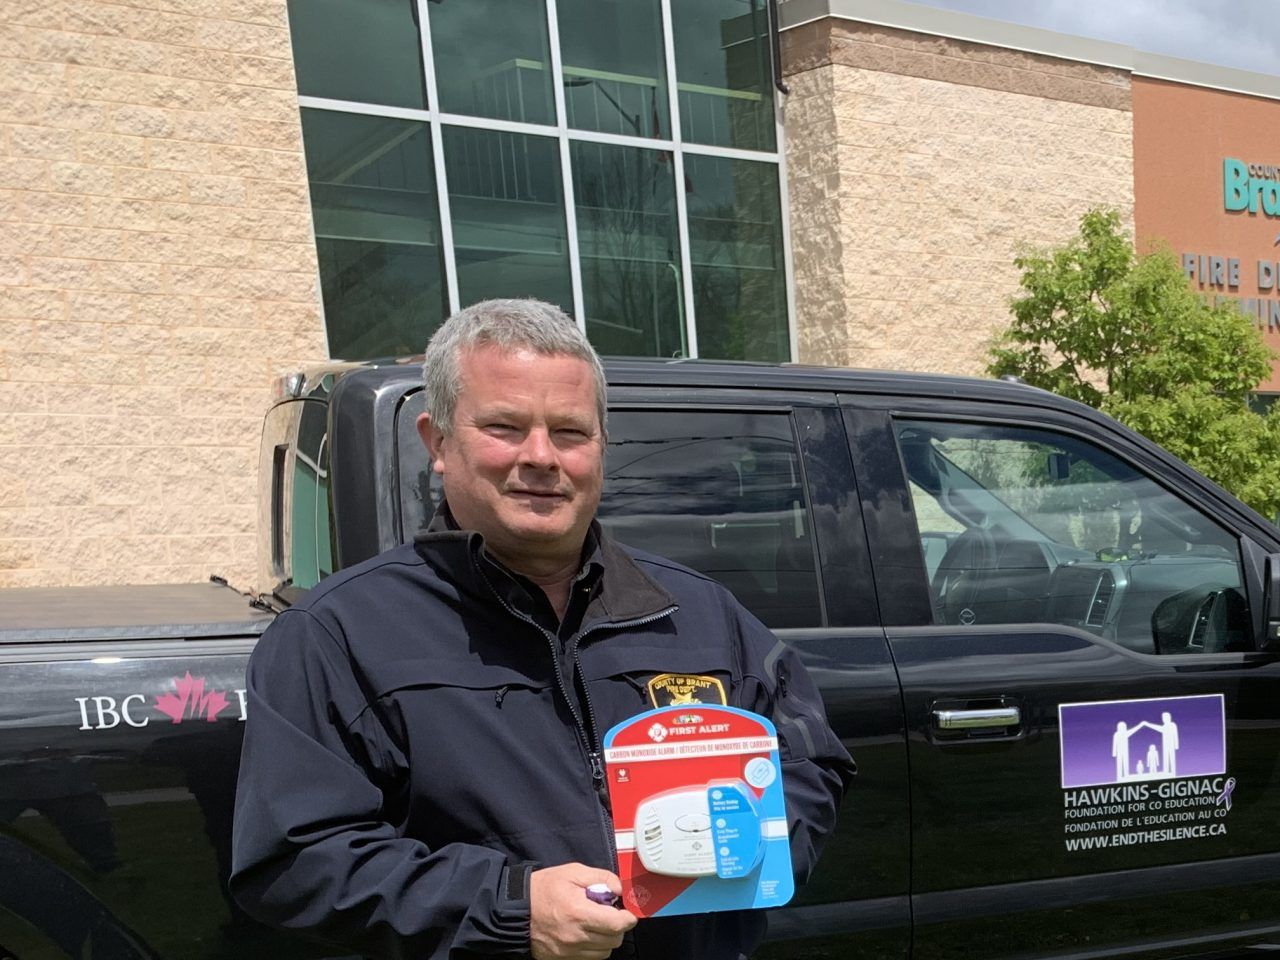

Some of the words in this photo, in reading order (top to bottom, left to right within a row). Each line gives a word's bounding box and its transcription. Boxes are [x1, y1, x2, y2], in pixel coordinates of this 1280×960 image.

[1183, 253, 1240, 288] FIRE
[655, 678, 675, 689] COUNTY
[686, 678, 711, 688] BRANT
[75, 694, 149, 730] IBC
[669, 726, 696, 736] FIRST
[699, 723, 730, 734] ALERT
[610, 750, 630, 759] CARBON
[631, 748, 656, 758] MONOXIDE
[658, 747, 674, 756] ALARM
[708, 743, 713, 752] DE
[715, 742, 741, 751] MONOXYDE
[743, 741, 748, 750] DE
[750, 740, 772, 749] CARBONE
[1064, 778, 1224, 807] HAWKINS-GIGNAC
[1064, 804, 1125, 819] FOUNDATION
[1128, 803, 1145, 812] FOR
[1150, 801, 1162, 811] CO
[1165, 796, 1215, 809] EDUCATION
[1064, 820, 1118, 833] FONDATION
[1122, 818, 1134, 827] DE
[1198, 809, 1211, 819] AU
[1214, 808, 1227, 818] CO
[1065, 823, 1227, 851] WWW.ENDTHESILENCE.CA
